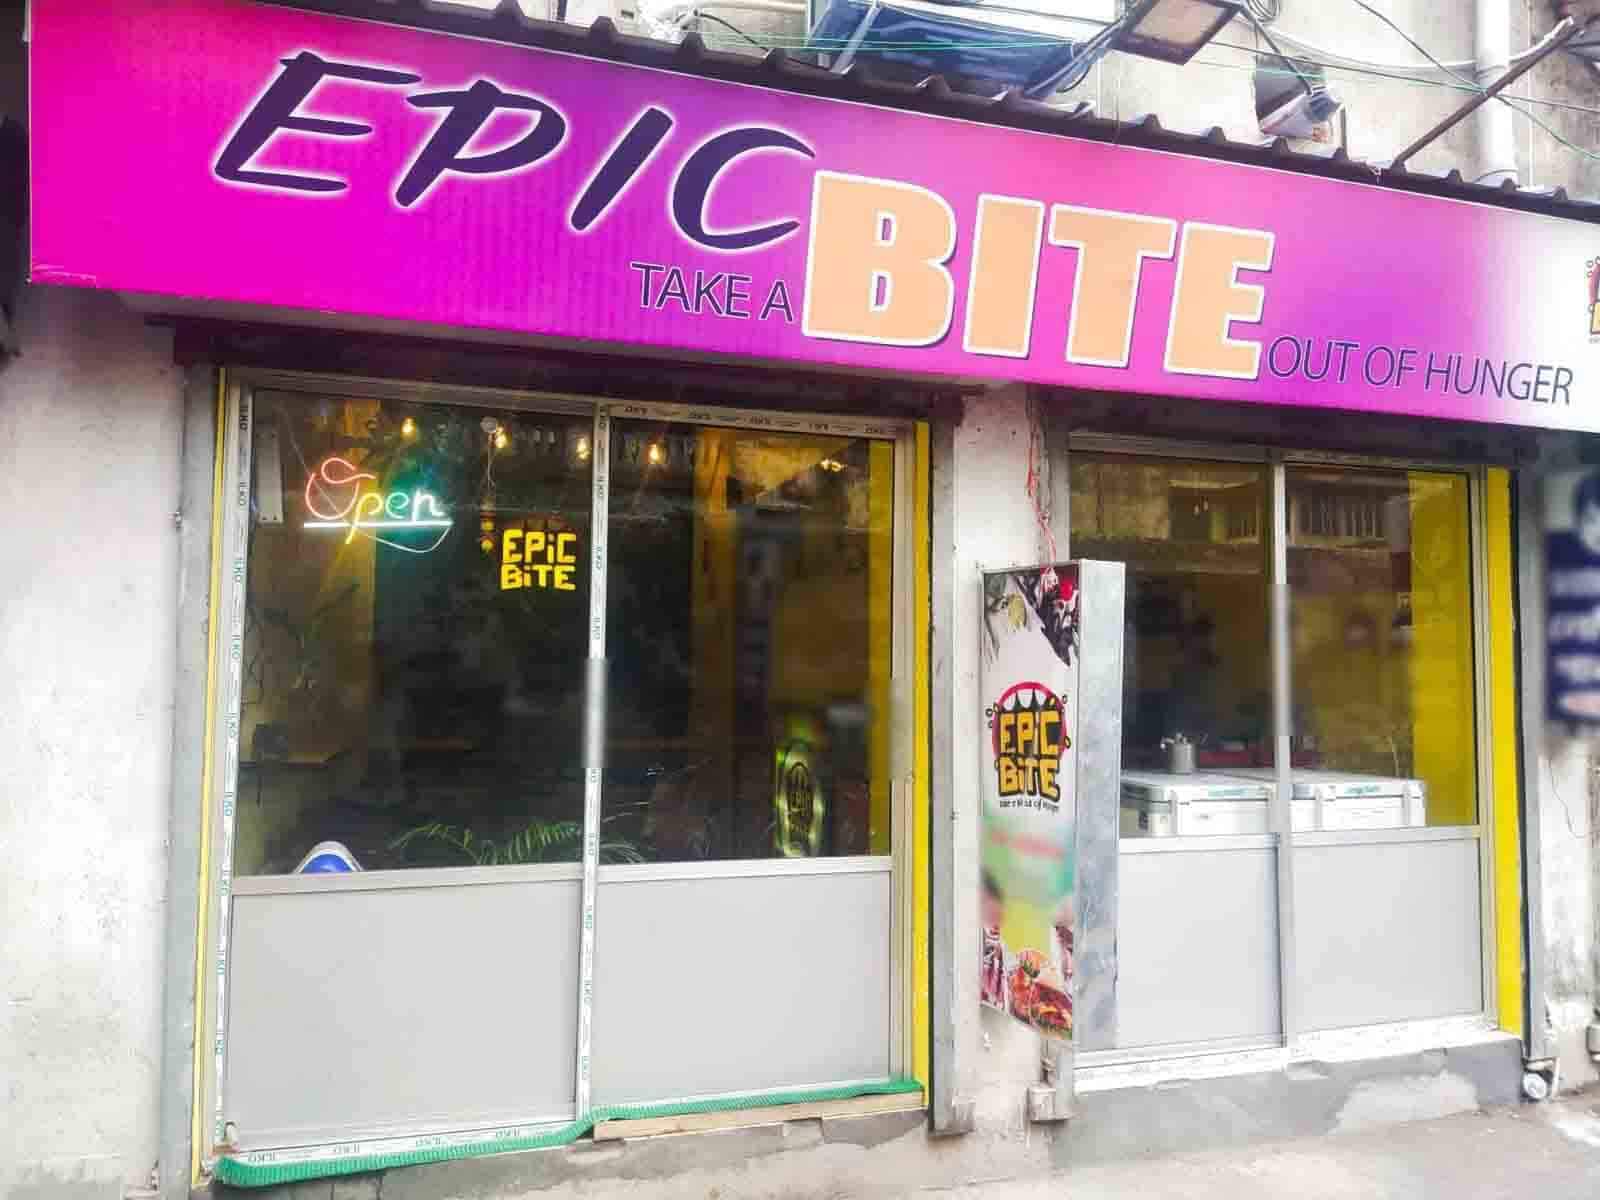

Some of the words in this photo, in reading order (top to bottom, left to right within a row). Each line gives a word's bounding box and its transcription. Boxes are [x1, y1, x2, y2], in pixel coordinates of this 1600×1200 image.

[213, 50, 815, 250] EPIC
[631, 262, 751, 319] TAKE
[759, 279, 793, 323] A
[802, 170, 1275, 380] BITE
[1268, 335, 1360, 383] OUT
[1364, 346, 1417, 388] OF
[1424, 351, 1574, 405] HUNGER
[305, 457, 446, 544] Open
